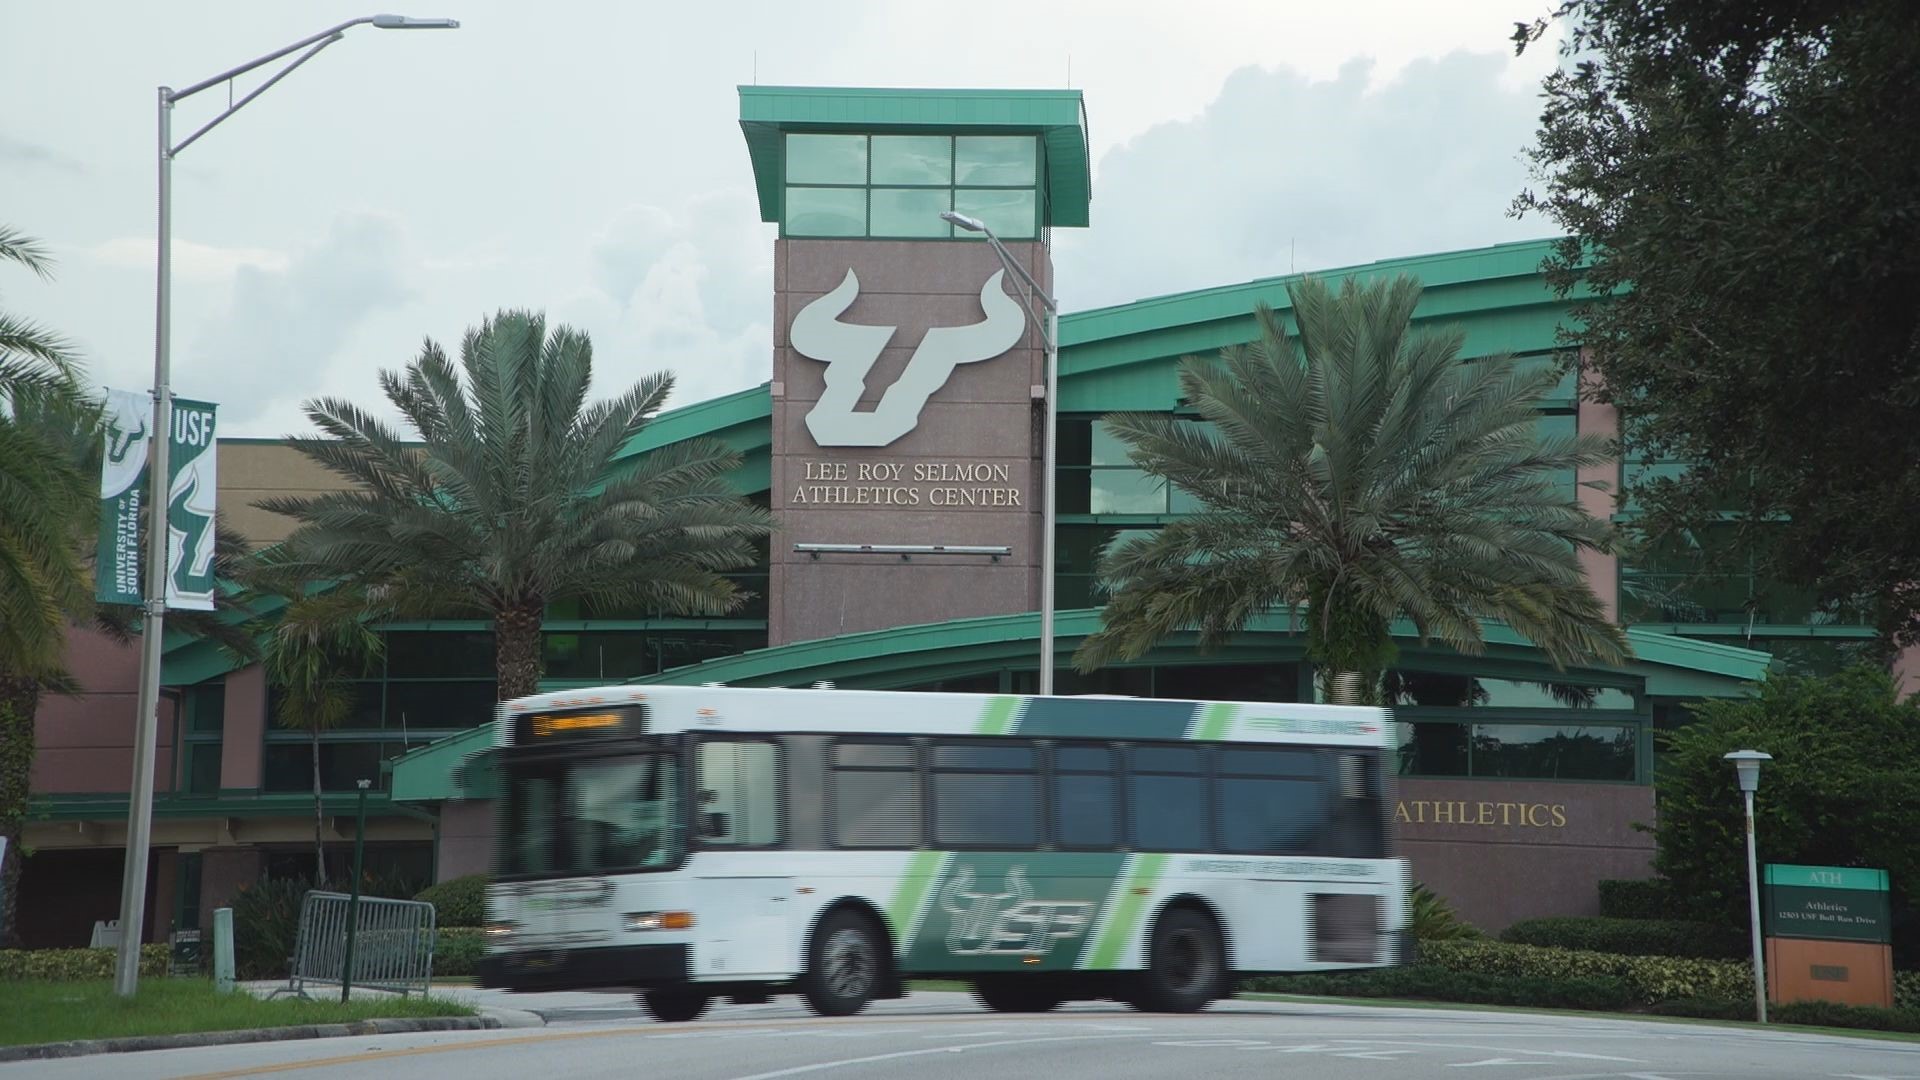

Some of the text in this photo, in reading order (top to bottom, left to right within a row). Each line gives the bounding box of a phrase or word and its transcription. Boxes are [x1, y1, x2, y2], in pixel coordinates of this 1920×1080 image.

[175, 409, 212, 447] USF
[805, 462, 1009, 482] LEE ROY SELMON
[792, 486, 1021, 506] ATHLETICS CENTER
[116, 498, 128, 593] UNIVERSITY OF
[127, 489, 140, 595] SOUTH FLORIDA
[1392, 801, 1567, 827] ATHLETICS
[1809, 871, 1842, 885] ATH
[1805, 901, 1848, 912] Athletics
[1855, 916, 1877, 925] Drive
